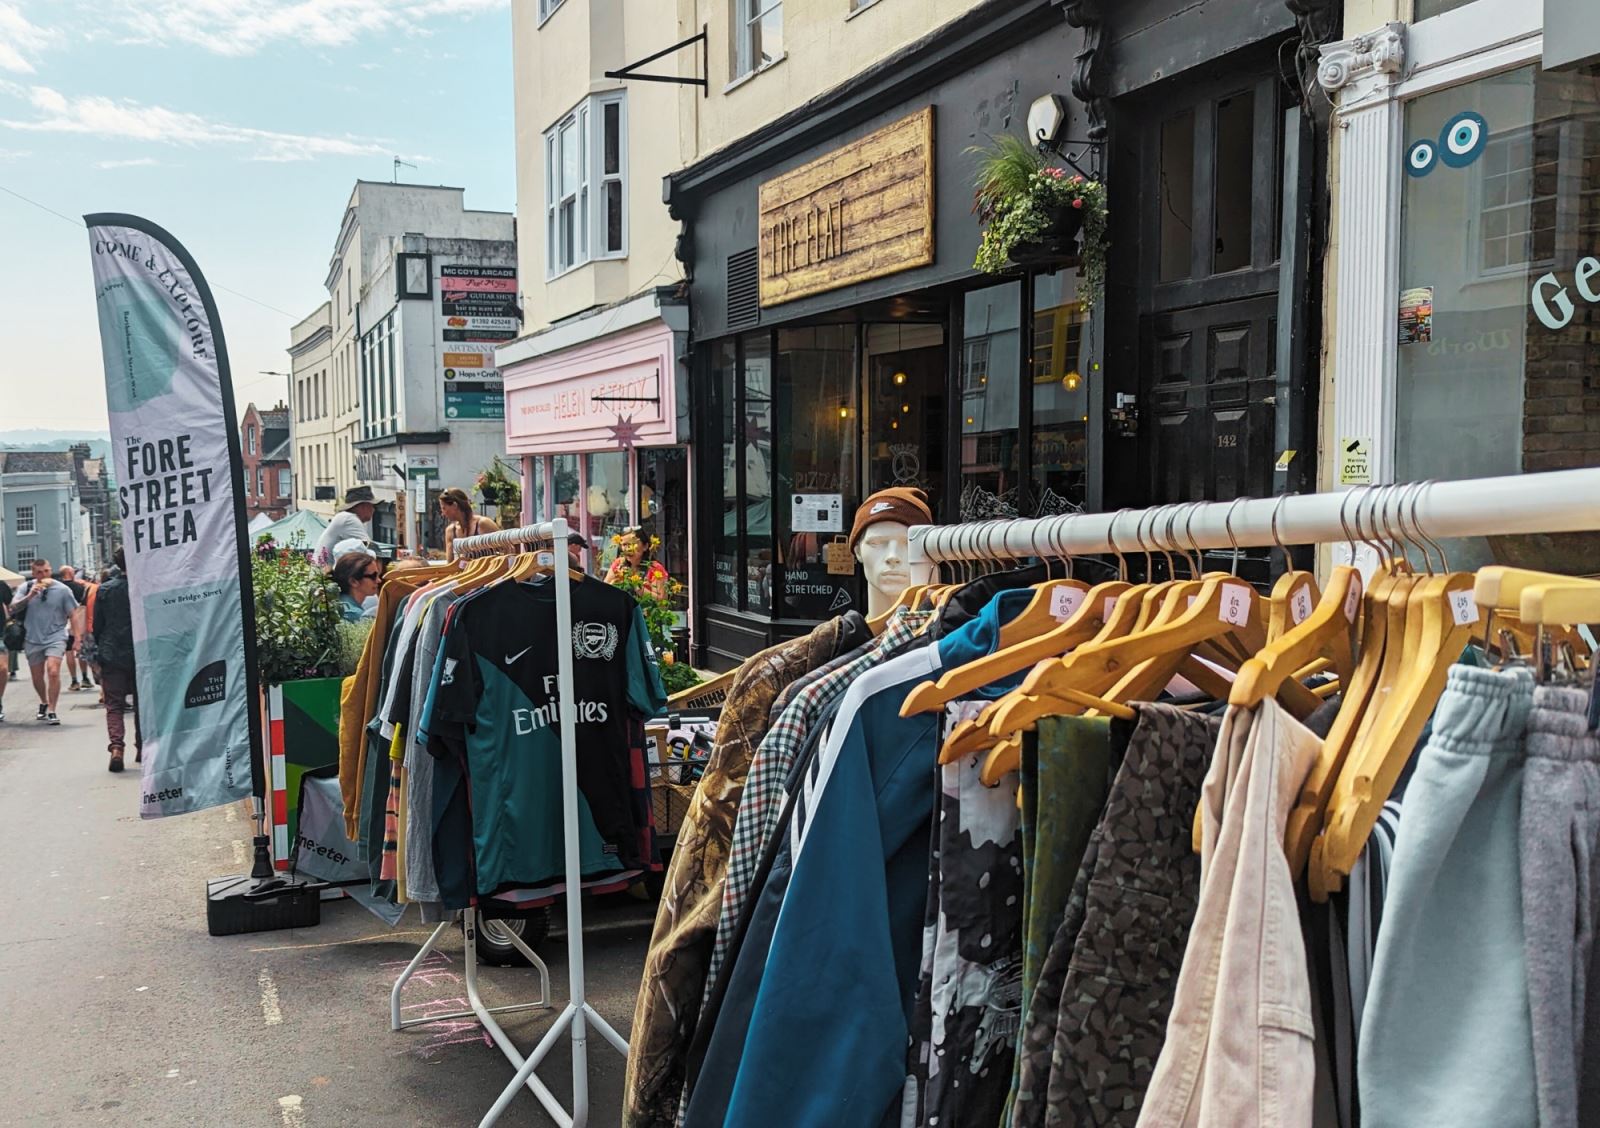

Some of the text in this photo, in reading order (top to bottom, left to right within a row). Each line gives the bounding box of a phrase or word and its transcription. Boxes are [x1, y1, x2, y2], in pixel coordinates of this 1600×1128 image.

[770, 198, 845, 278] THE FLAT
[481, 269, 514, 277] ARCADE
[96, 240, 208, 359] COME & EXPLORE
[458, 370, 476, 378] Hops
[553, 387, 586, 420] HELEN
[124, 436, 142, 446] The
[1217, 434, 1237, 448] 142
[127, 434, 194, 480] FORE
[1344, 465, 1368, 474] CCTV
[119, 468, 213, 519] STREET
[133, 509, 198, 554] FLEA
[784, 571, 809, 580] HAND
[177, 593, 201, 602] Bridge
[202, 588, 222, 599] Street
[785, 585, 833, 595] STRETCHED
[208, 675, 224, 684] THE
[203, 684, 224, 693] WEST
[512, 696, 608, 735] Emites
